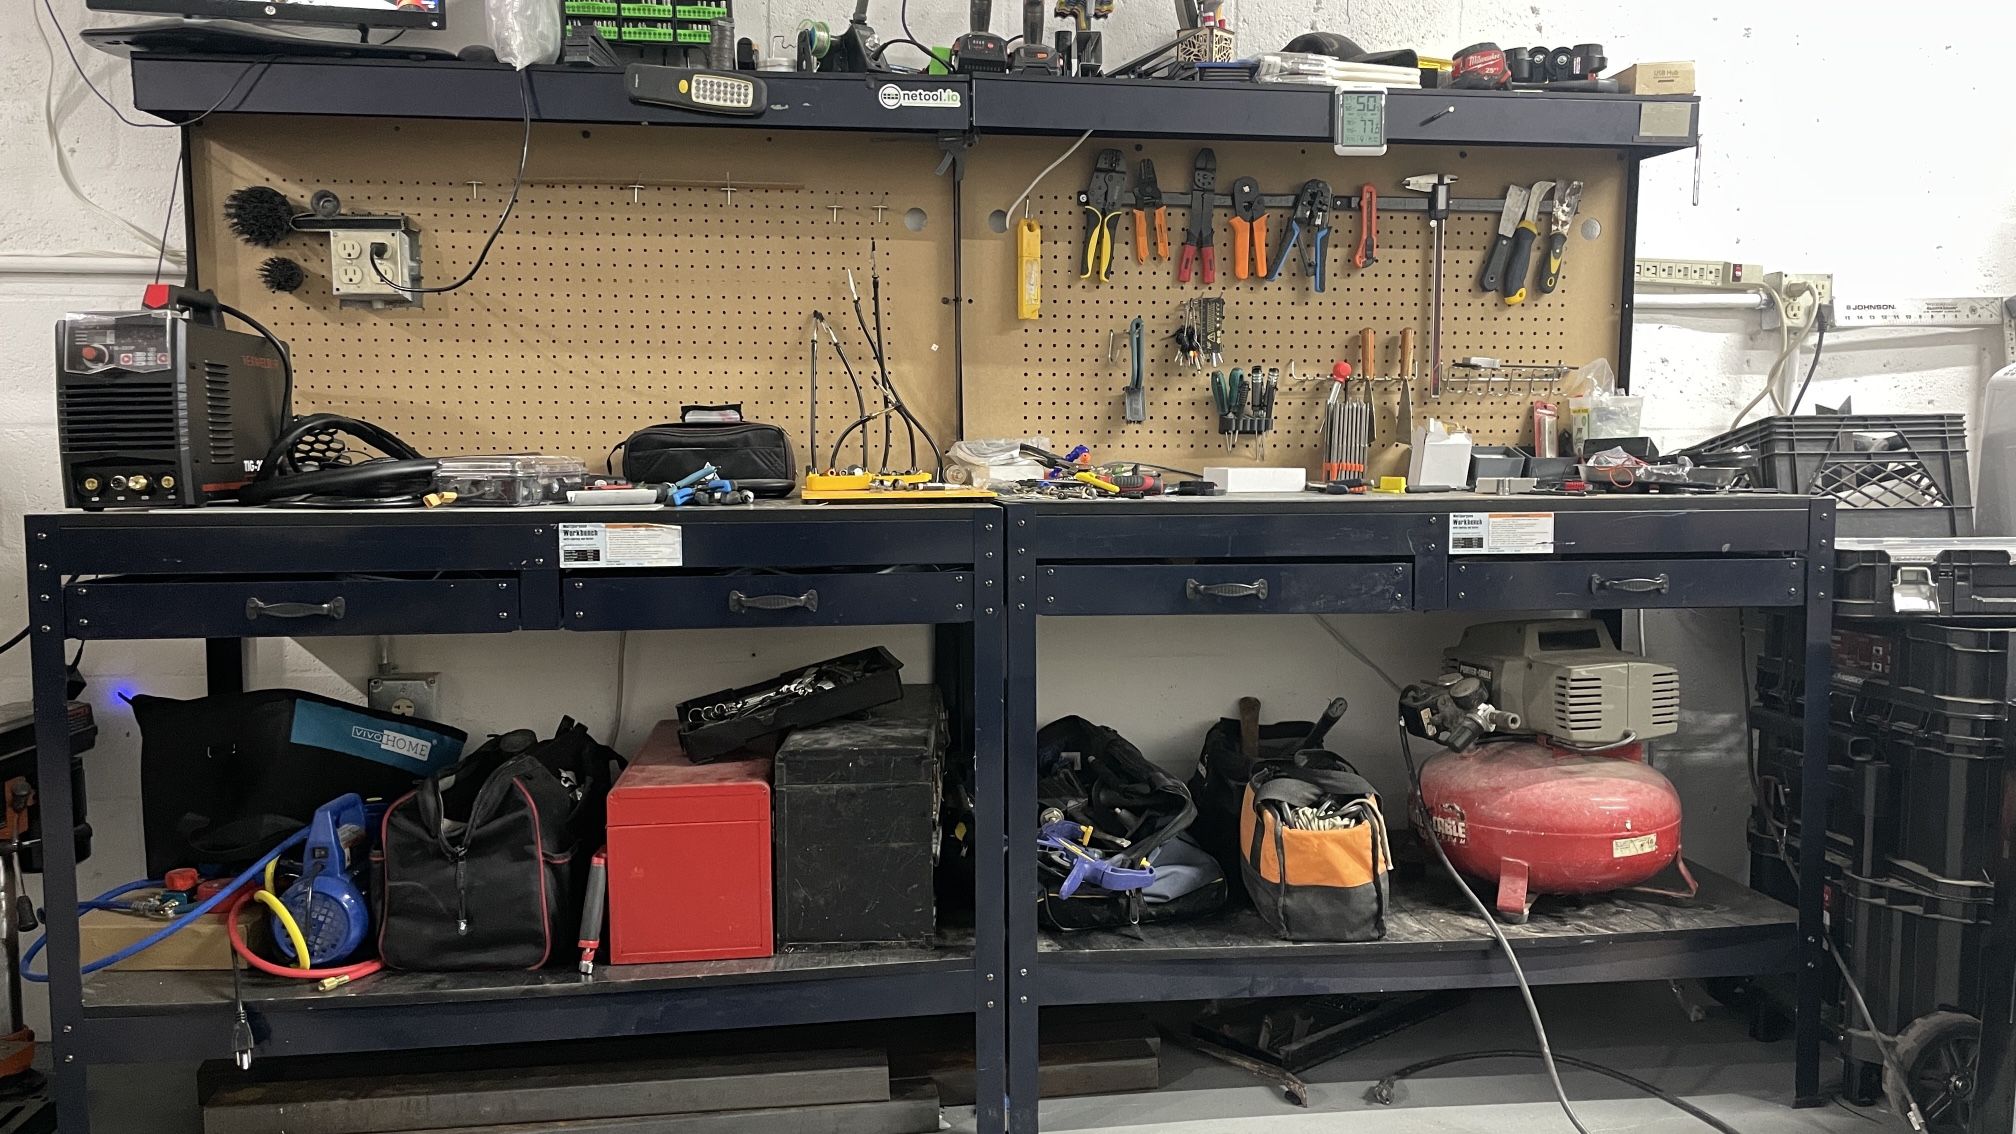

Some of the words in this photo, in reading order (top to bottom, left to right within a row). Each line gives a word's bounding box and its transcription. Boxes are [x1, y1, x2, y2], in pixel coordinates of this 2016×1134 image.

[902, 91, 958, 102] netool.io
[1356, 95, 1377, 111] 50
[243, 459, 264, 473] TIG-2
